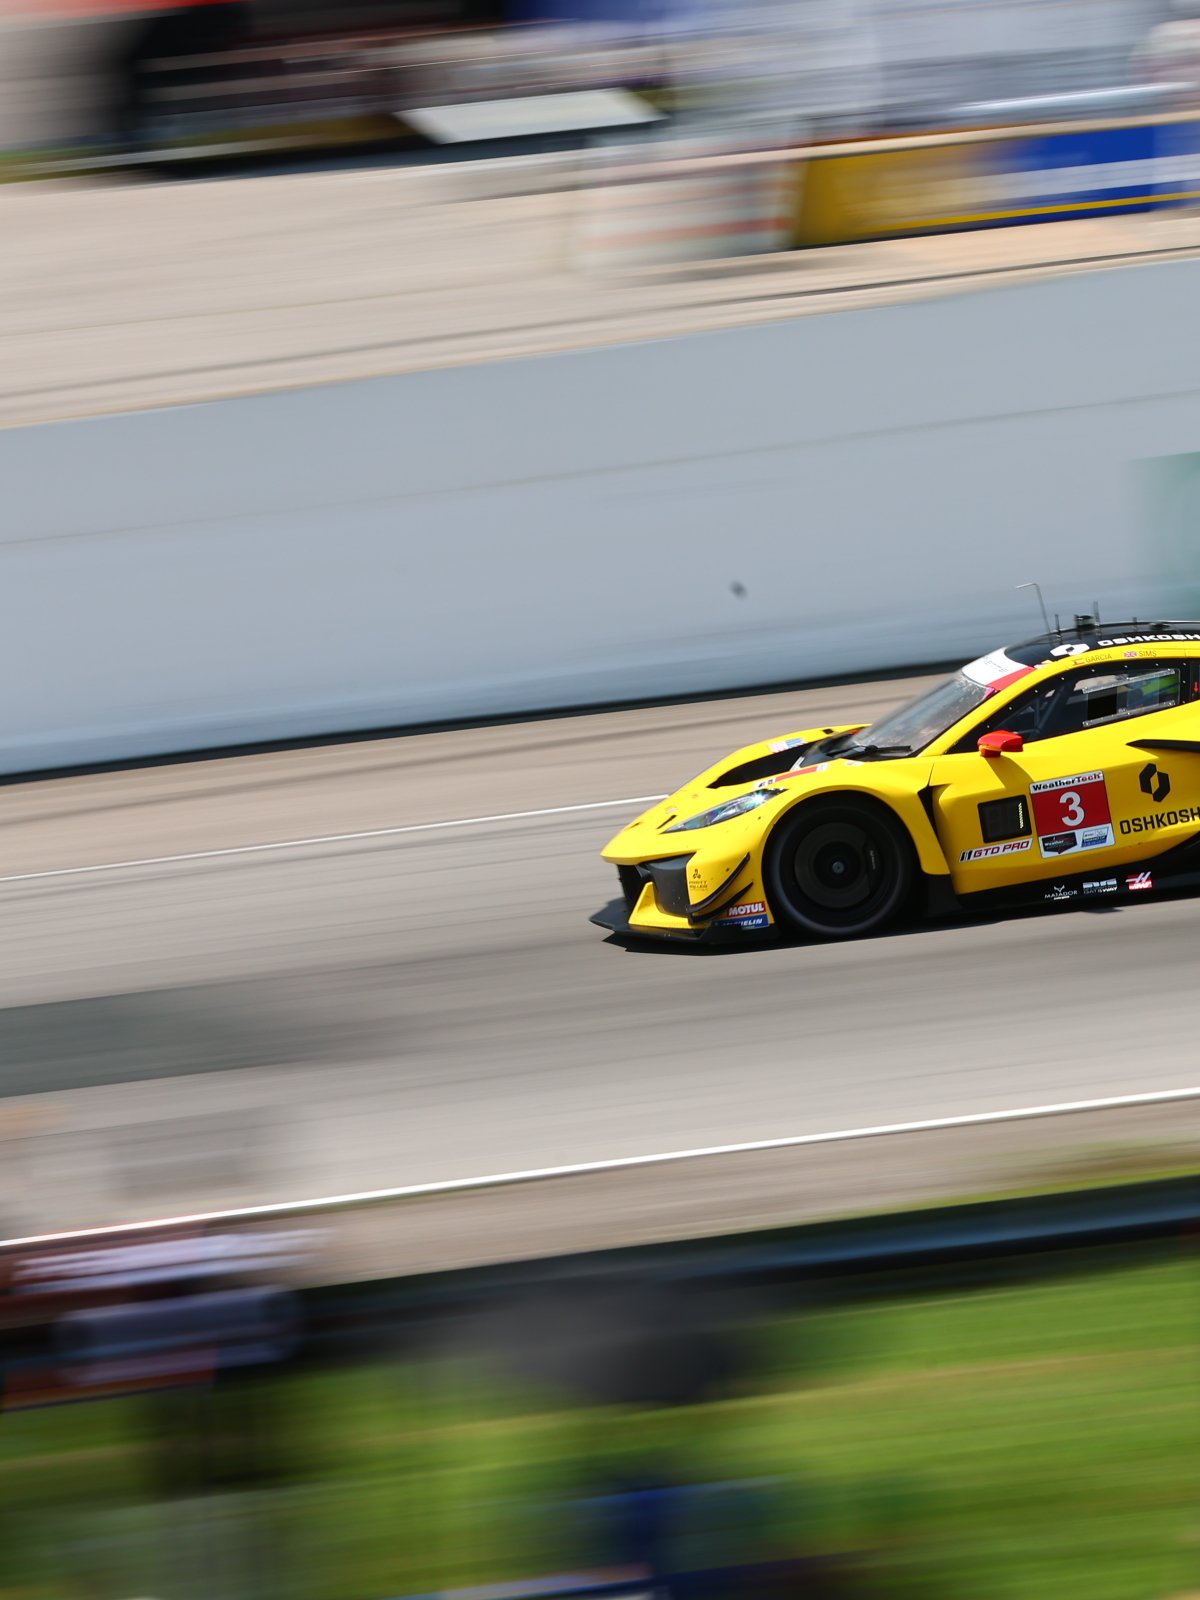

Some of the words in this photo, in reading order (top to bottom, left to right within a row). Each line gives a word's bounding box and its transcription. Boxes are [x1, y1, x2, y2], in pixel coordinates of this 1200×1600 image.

[1085, 653, 1112, 664] GARCIA
[1139, 650, 1157, 658] SIMS
[1032, 772, 1101, 791] WeatherTech
[1059, 791, 1085, 826] 3
[973, 846, 1001, 858] GTD
[1002, 840, 1030, 852] PRO
[1044, 890, 1078, 899] MATADOR
[728, 903, 765, 916] MOTUL
